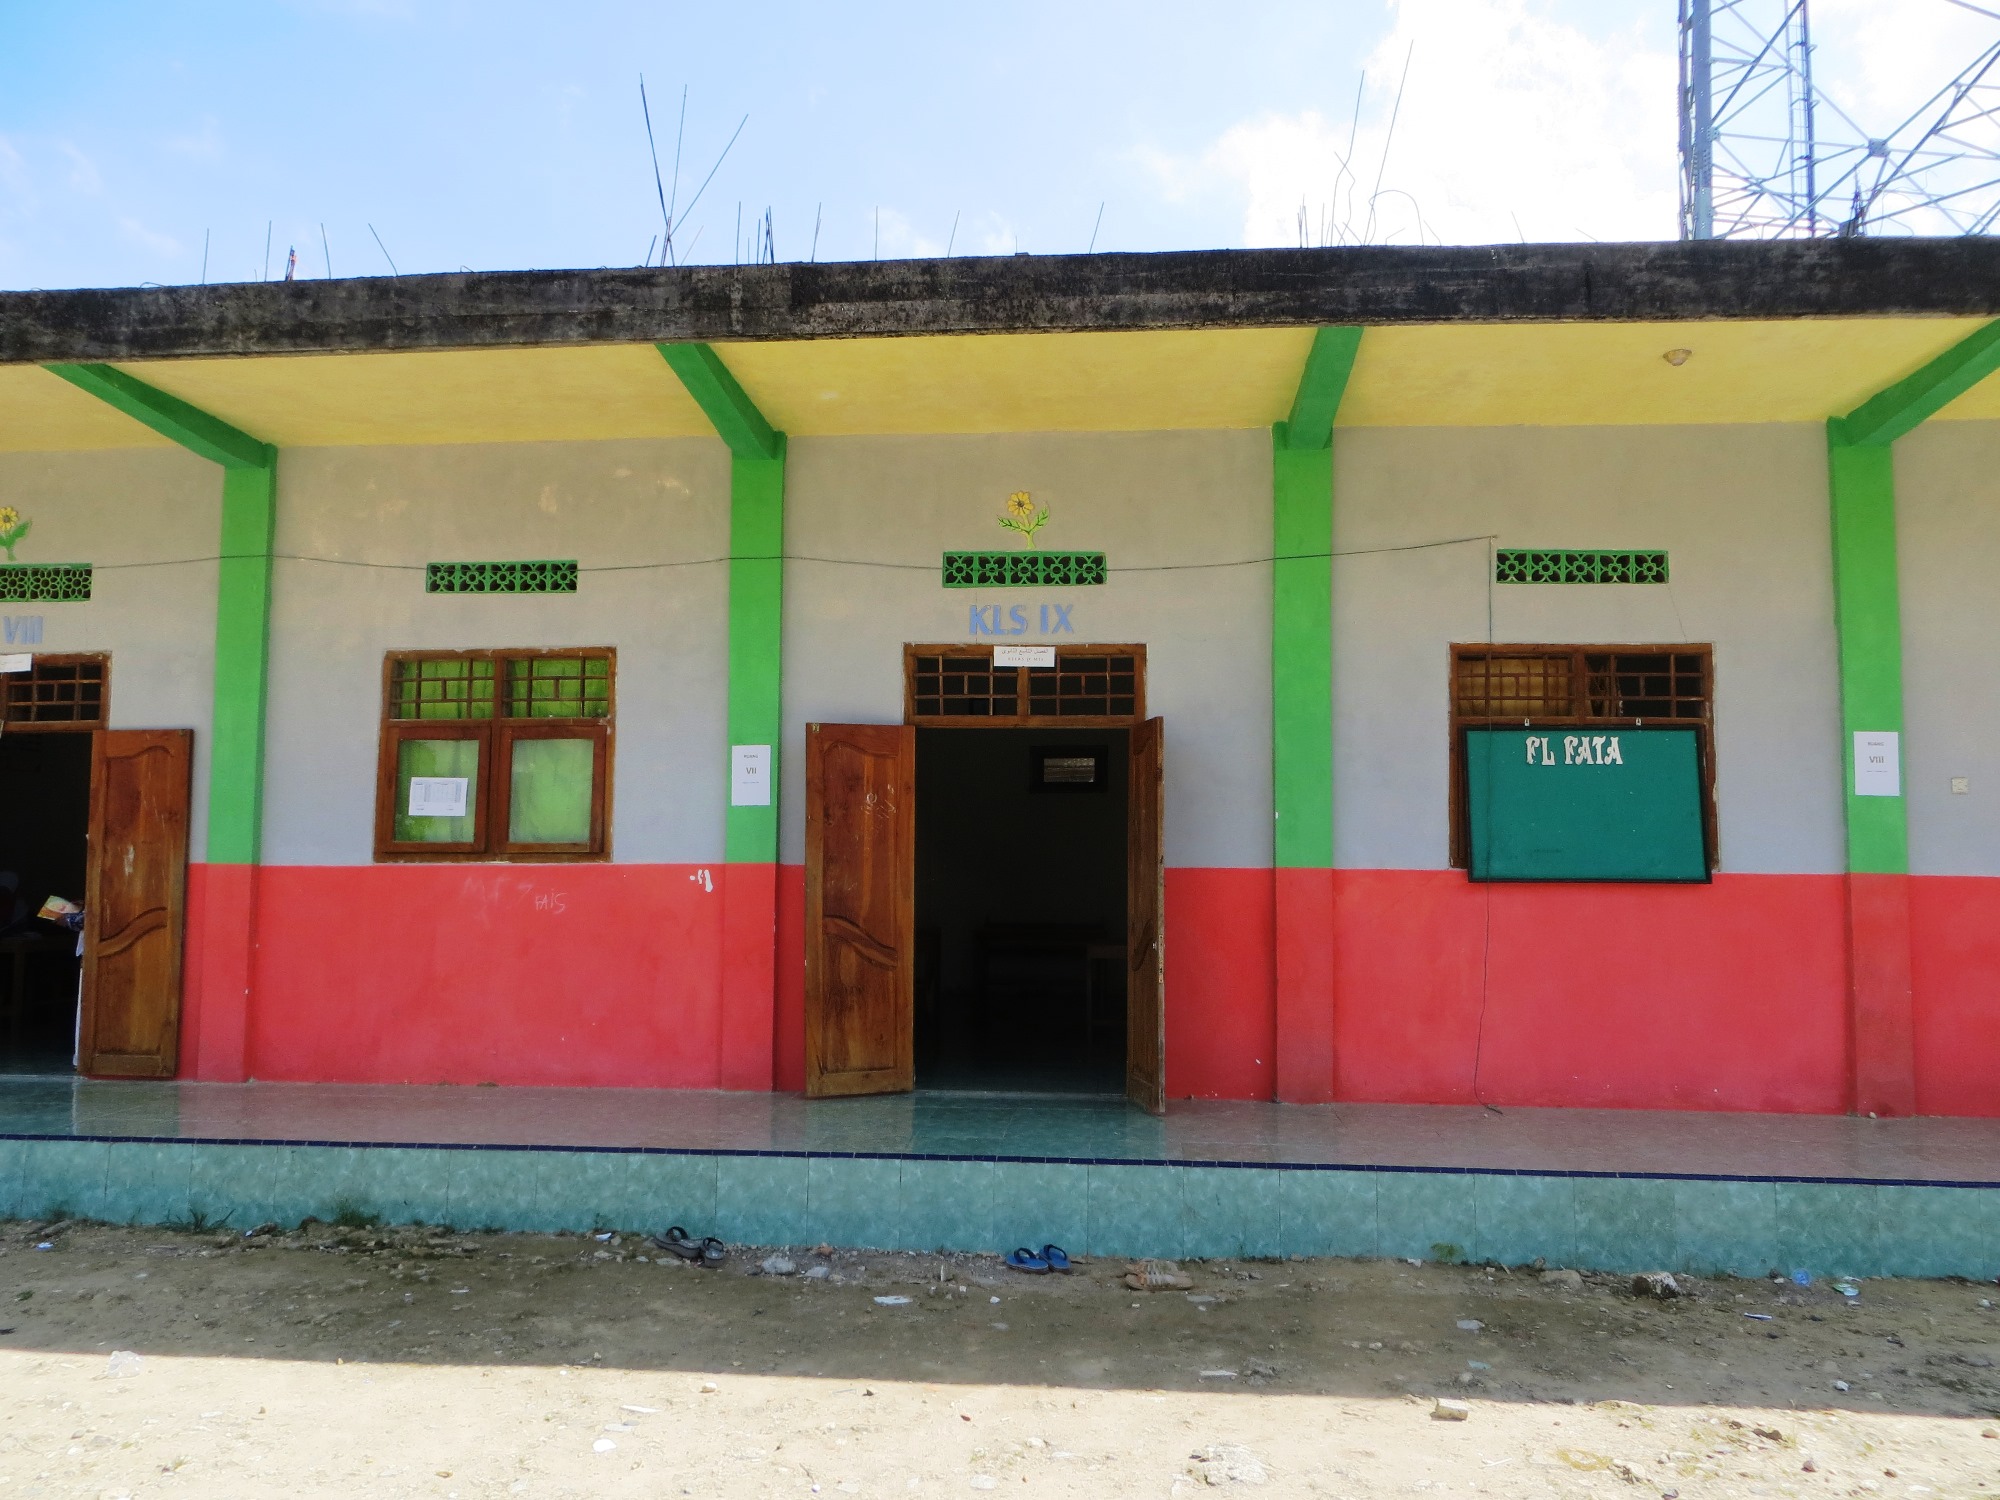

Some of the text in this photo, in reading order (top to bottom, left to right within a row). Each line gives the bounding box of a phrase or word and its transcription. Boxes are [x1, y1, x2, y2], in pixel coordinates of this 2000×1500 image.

[968, 604, 1074, 635] KLS IX
[1868, 755, 1884, 764] VIII
[745, 767, 757, 775] VII
